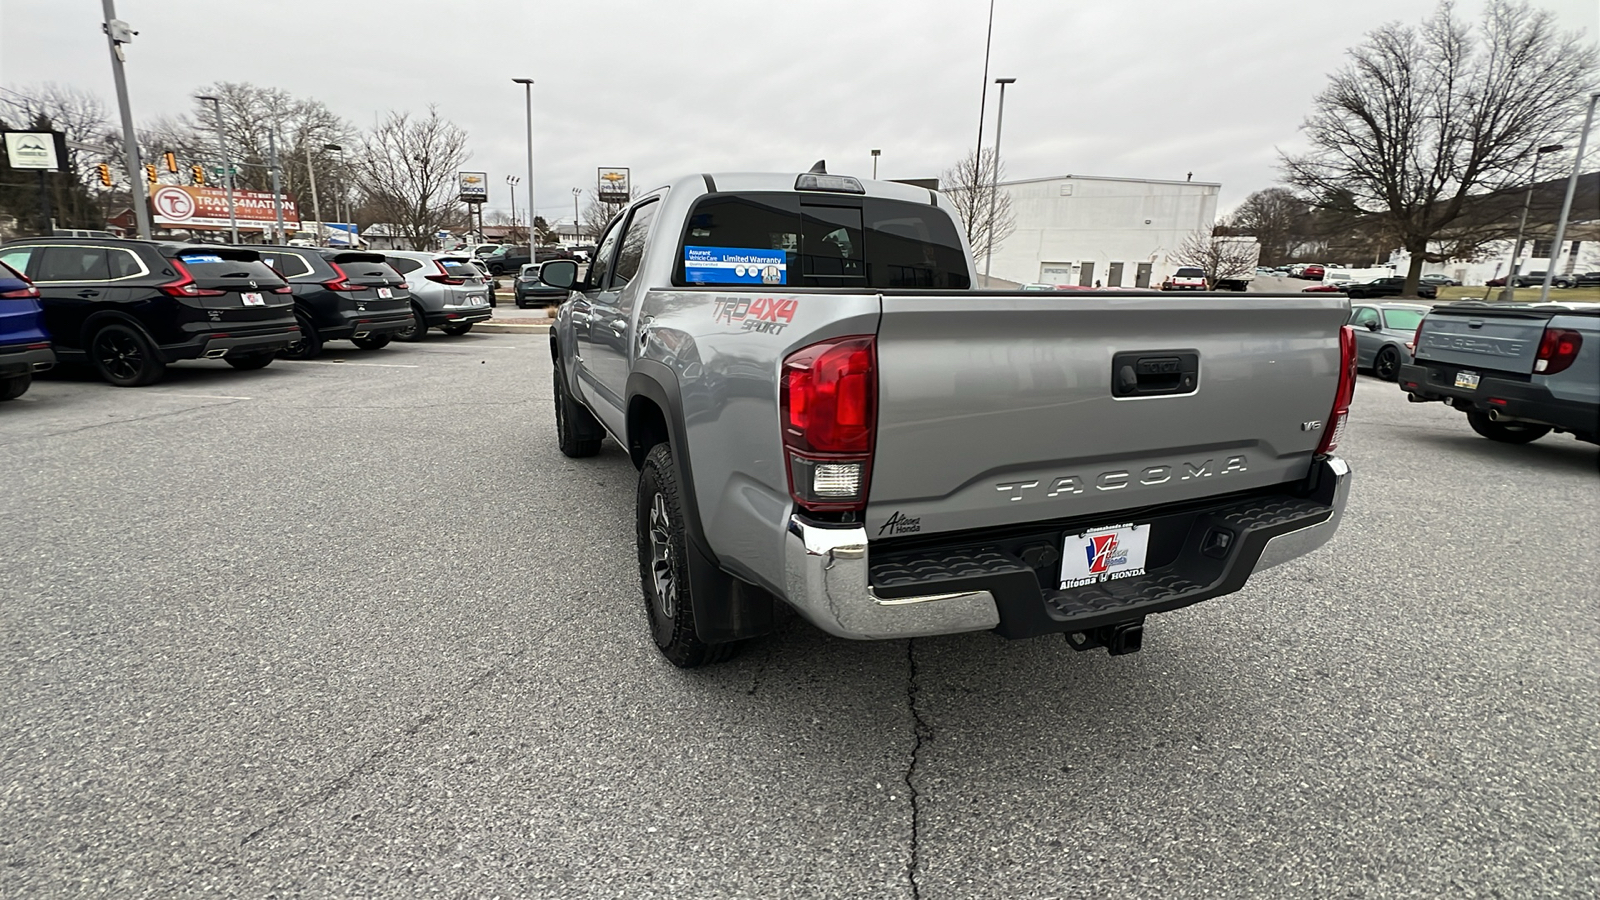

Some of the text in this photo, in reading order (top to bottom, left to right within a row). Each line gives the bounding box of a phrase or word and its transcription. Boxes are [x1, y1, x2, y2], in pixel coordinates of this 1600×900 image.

[232, 207, 295, 216] CHURH
[723, 255, 782, 265] Limited Warranty
[713, 296, 752, 326] TRD
[740, 319, 789, 335] SPORT
[1300, 420, 1321, 431] V6
[996, 455, 1247, 501] TACOMA
[896, 525, 920, 534] Honda
[1060, 577, 1097, 590] Altoona
[1111, 568, 1146, 581] HONDA
